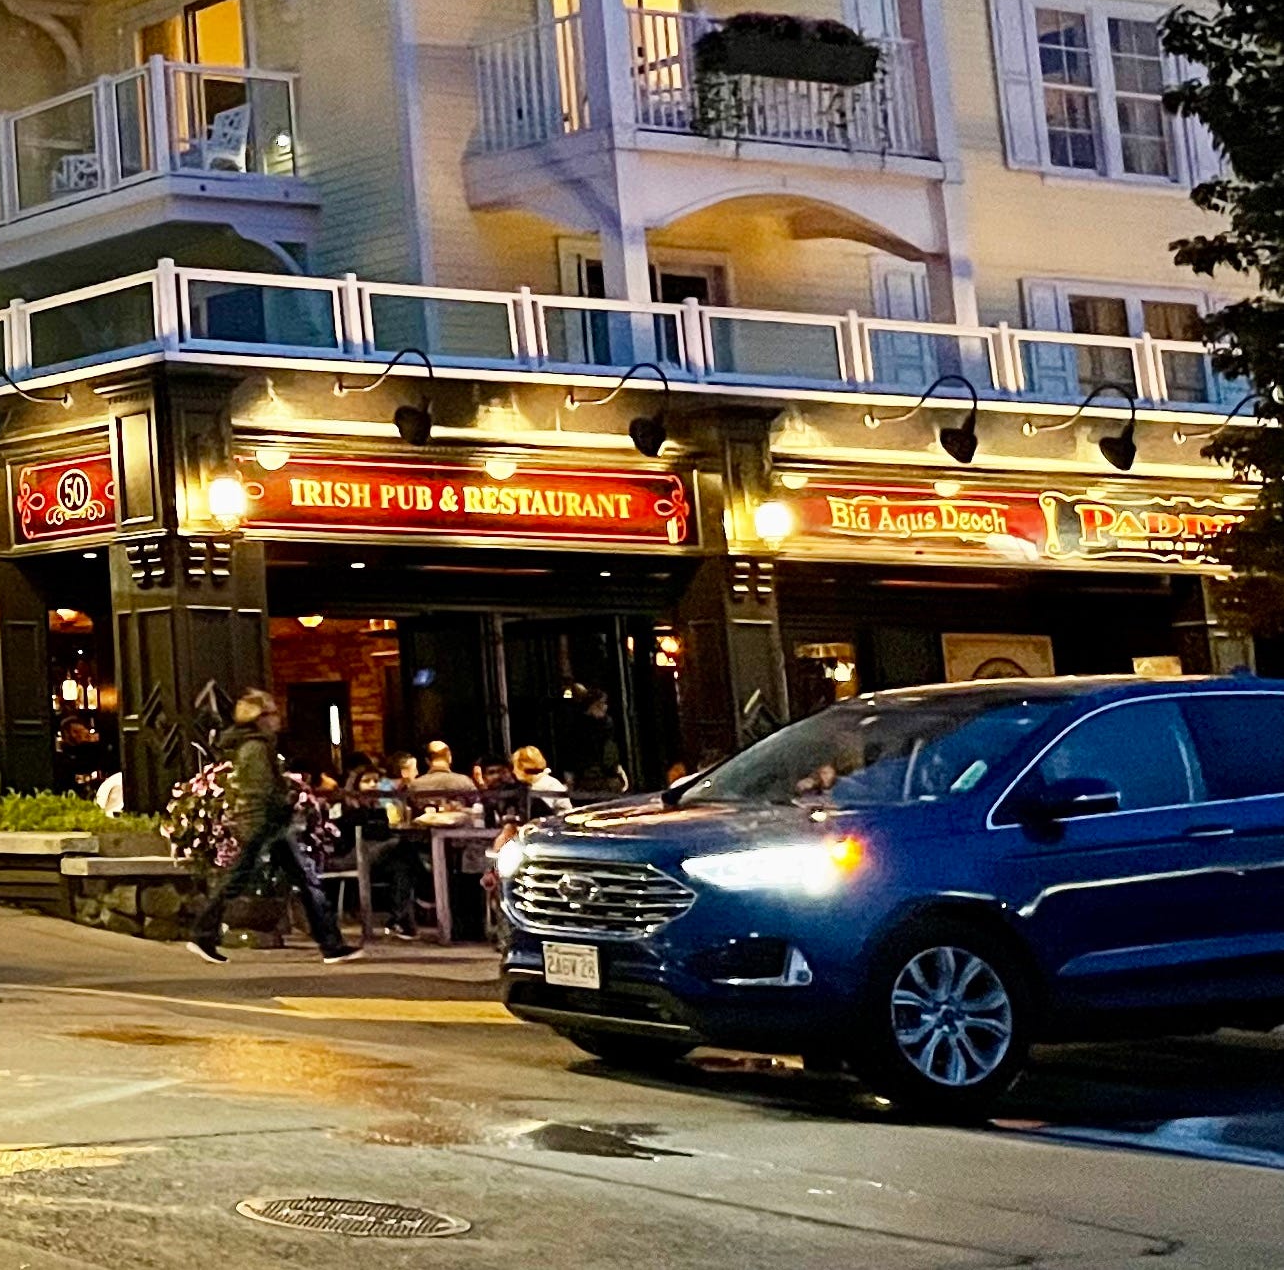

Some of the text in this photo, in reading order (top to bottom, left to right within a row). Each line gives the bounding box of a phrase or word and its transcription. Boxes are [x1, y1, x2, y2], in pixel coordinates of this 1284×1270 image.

[64, 476, 85, 508] 50
[289, 479, 632, 519] IRISH PUB & RESTAURANT
[878, 507, 937, 539] Agus
[939, 504, 1008, 533] Deoch
